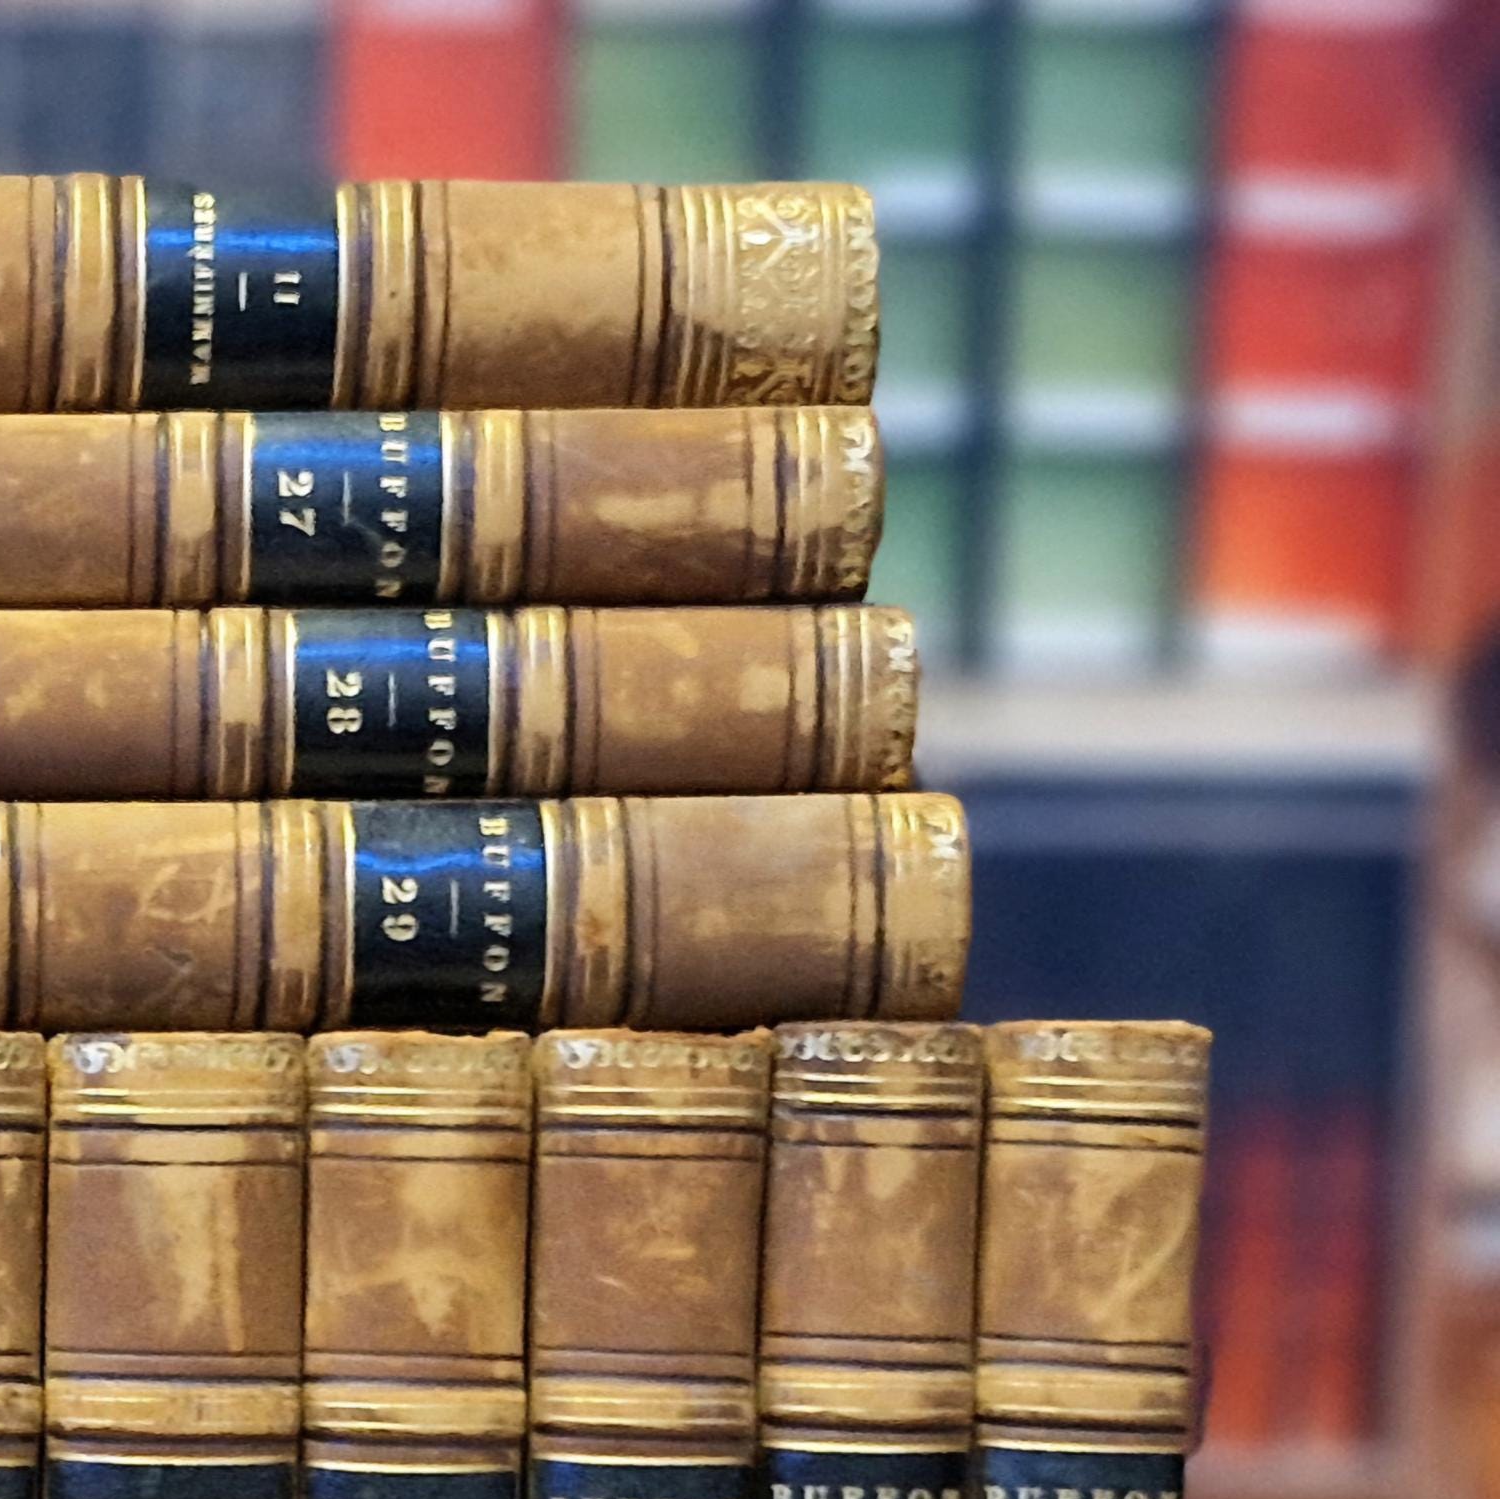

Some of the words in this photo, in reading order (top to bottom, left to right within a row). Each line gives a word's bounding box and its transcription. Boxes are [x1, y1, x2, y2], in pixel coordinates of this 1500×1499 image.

[273, 270, 302, 305] 11
[277, 468, 317, 537] 27
[376, 412, 409, 598] BUFFON
[326, 666, 363, 734] 28
[424, 612, 457, 793] BUFFON
[381, 875, 419, 942] 29
[479, 816, 513, 1002] BUFFON
